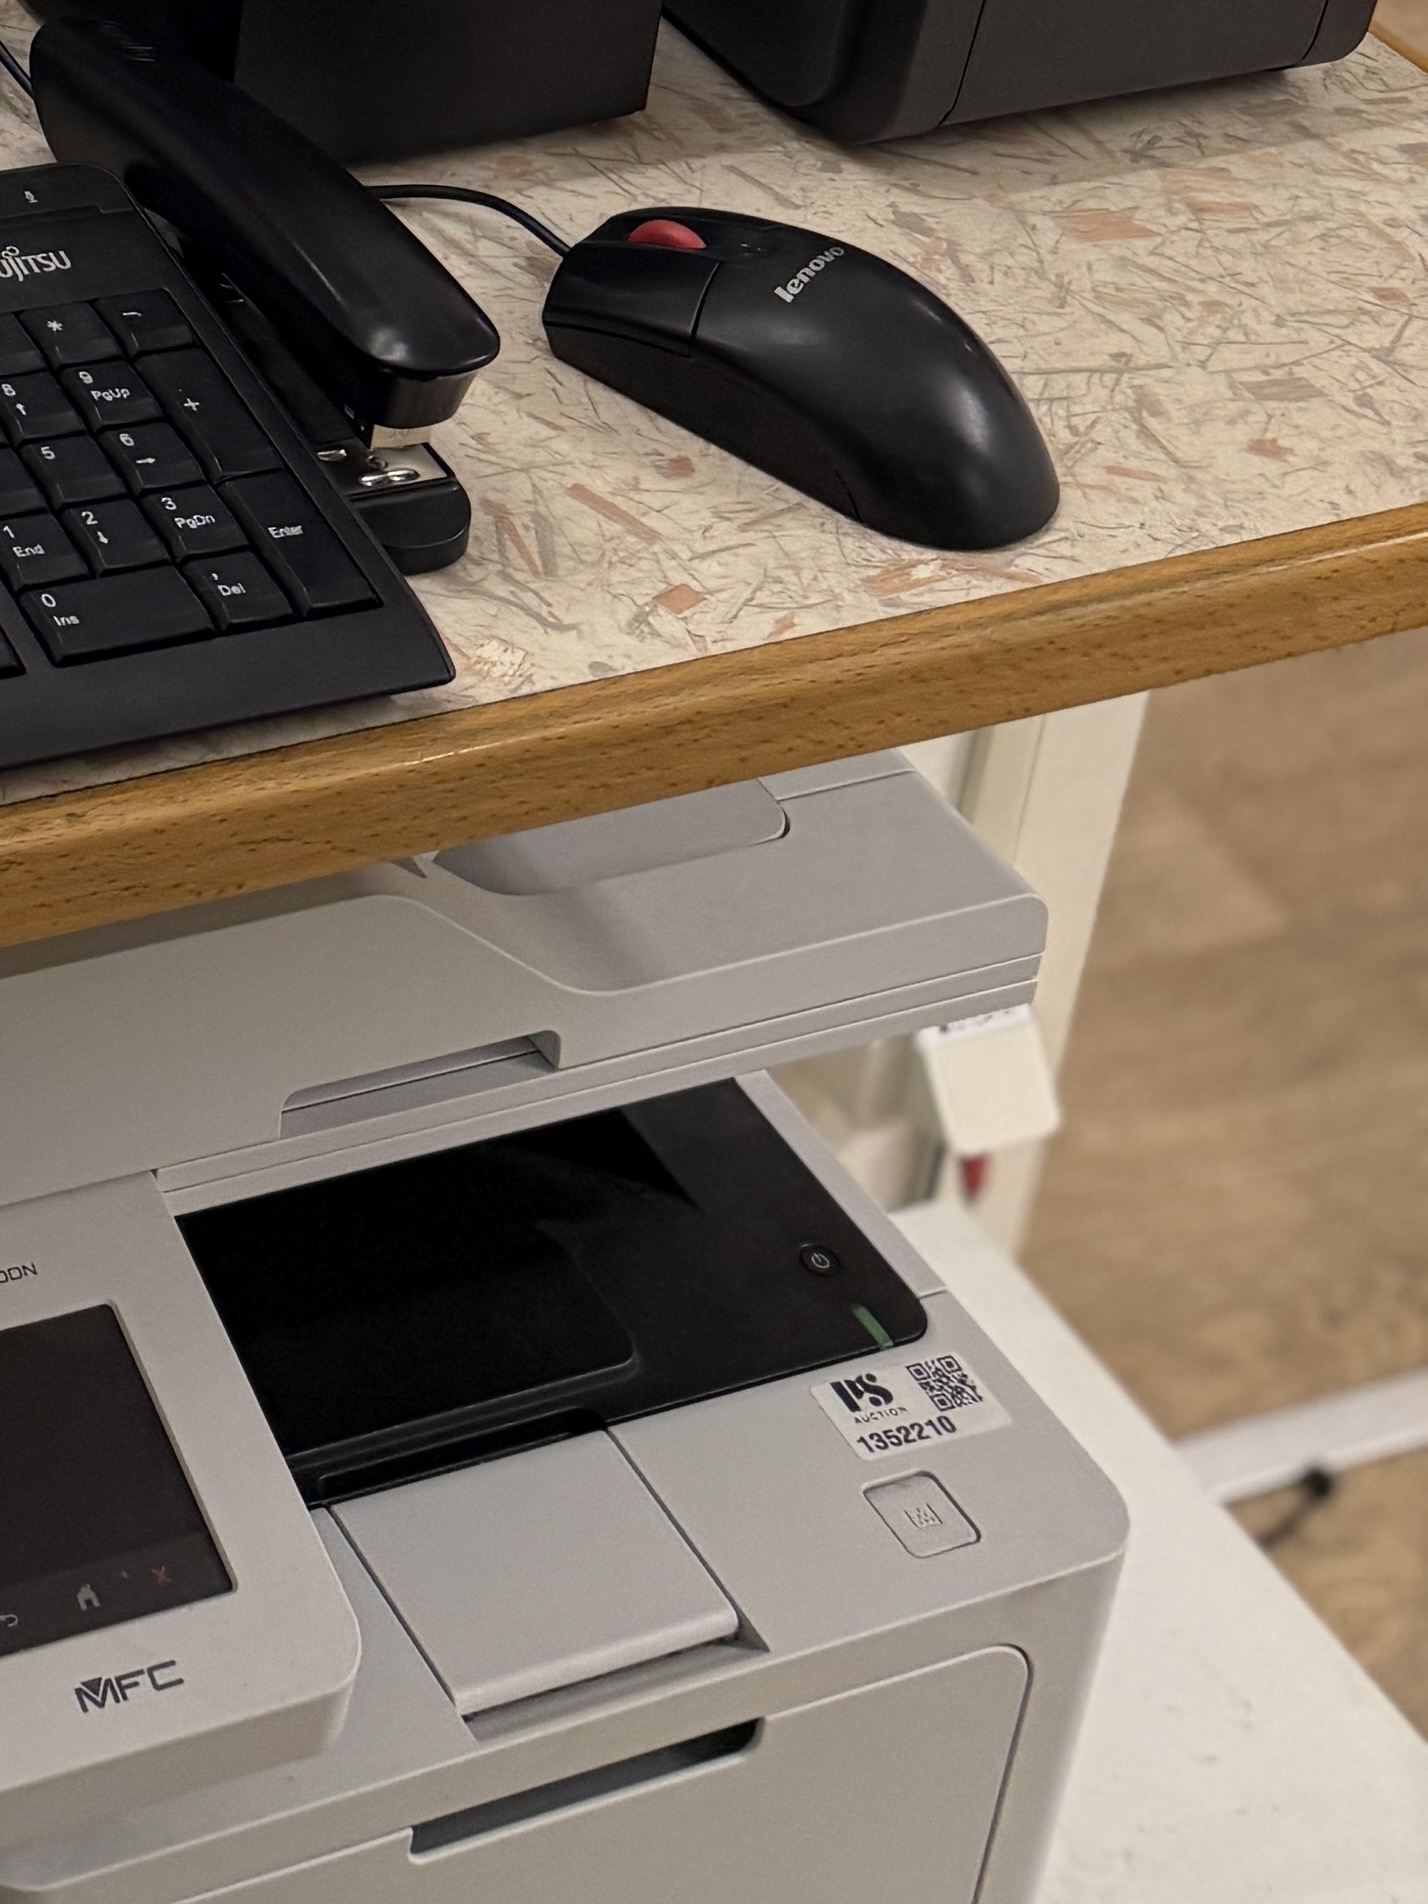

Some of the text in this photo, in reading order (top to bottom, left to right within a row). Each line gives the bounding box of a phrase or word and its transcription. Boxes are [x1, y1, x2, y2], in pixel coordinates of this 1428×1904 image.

[773, 245, 845, 304] lenovo
[854, 1405, 909, 1424] AUCTION
[856, 1414, 958, 1454] 1352210
[74, 1658, 186, 1714] MFC
